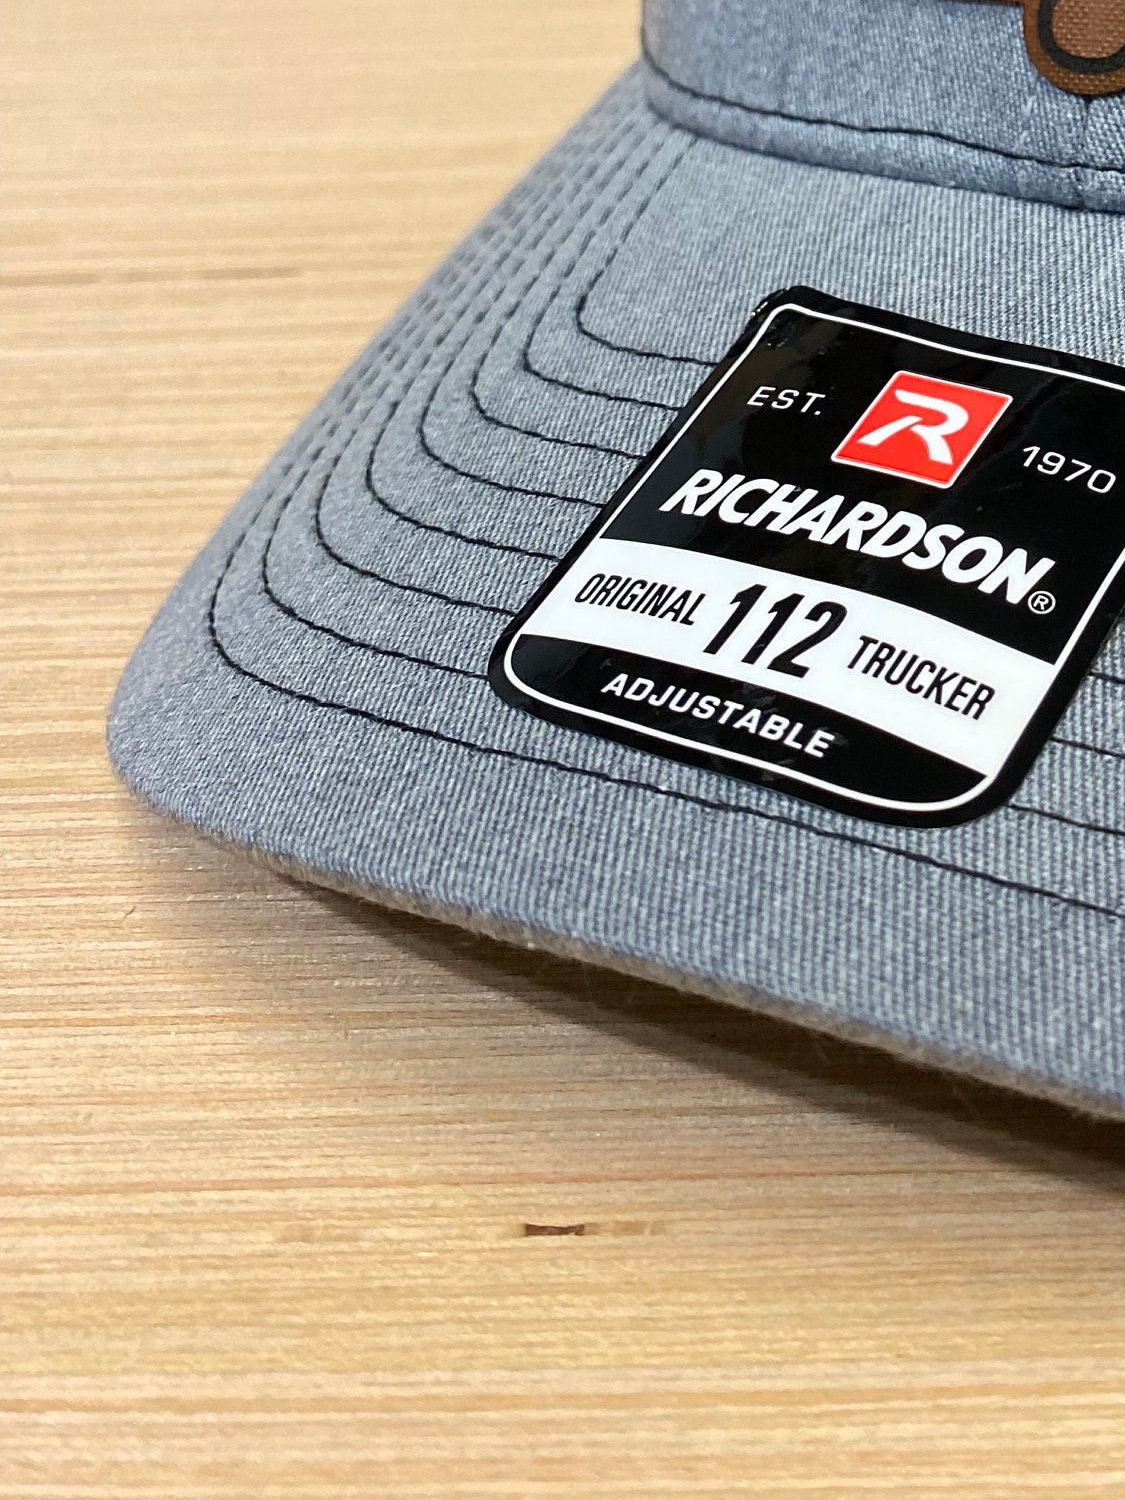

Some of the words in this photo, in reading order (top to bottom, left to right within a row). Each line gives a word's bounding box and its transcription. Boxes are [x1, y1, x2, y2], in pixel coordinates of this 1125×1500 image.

[746, 385, 825, 417] EST.
[1022, 444, 1117, 494] 1970
[574, 573, 708, 627] ORIGINAL
[703, 583, 849, 679] 112
[848, 635, 997, 721] TRUCKER
[600, 672, 836, 760] ADJUSTABLE
